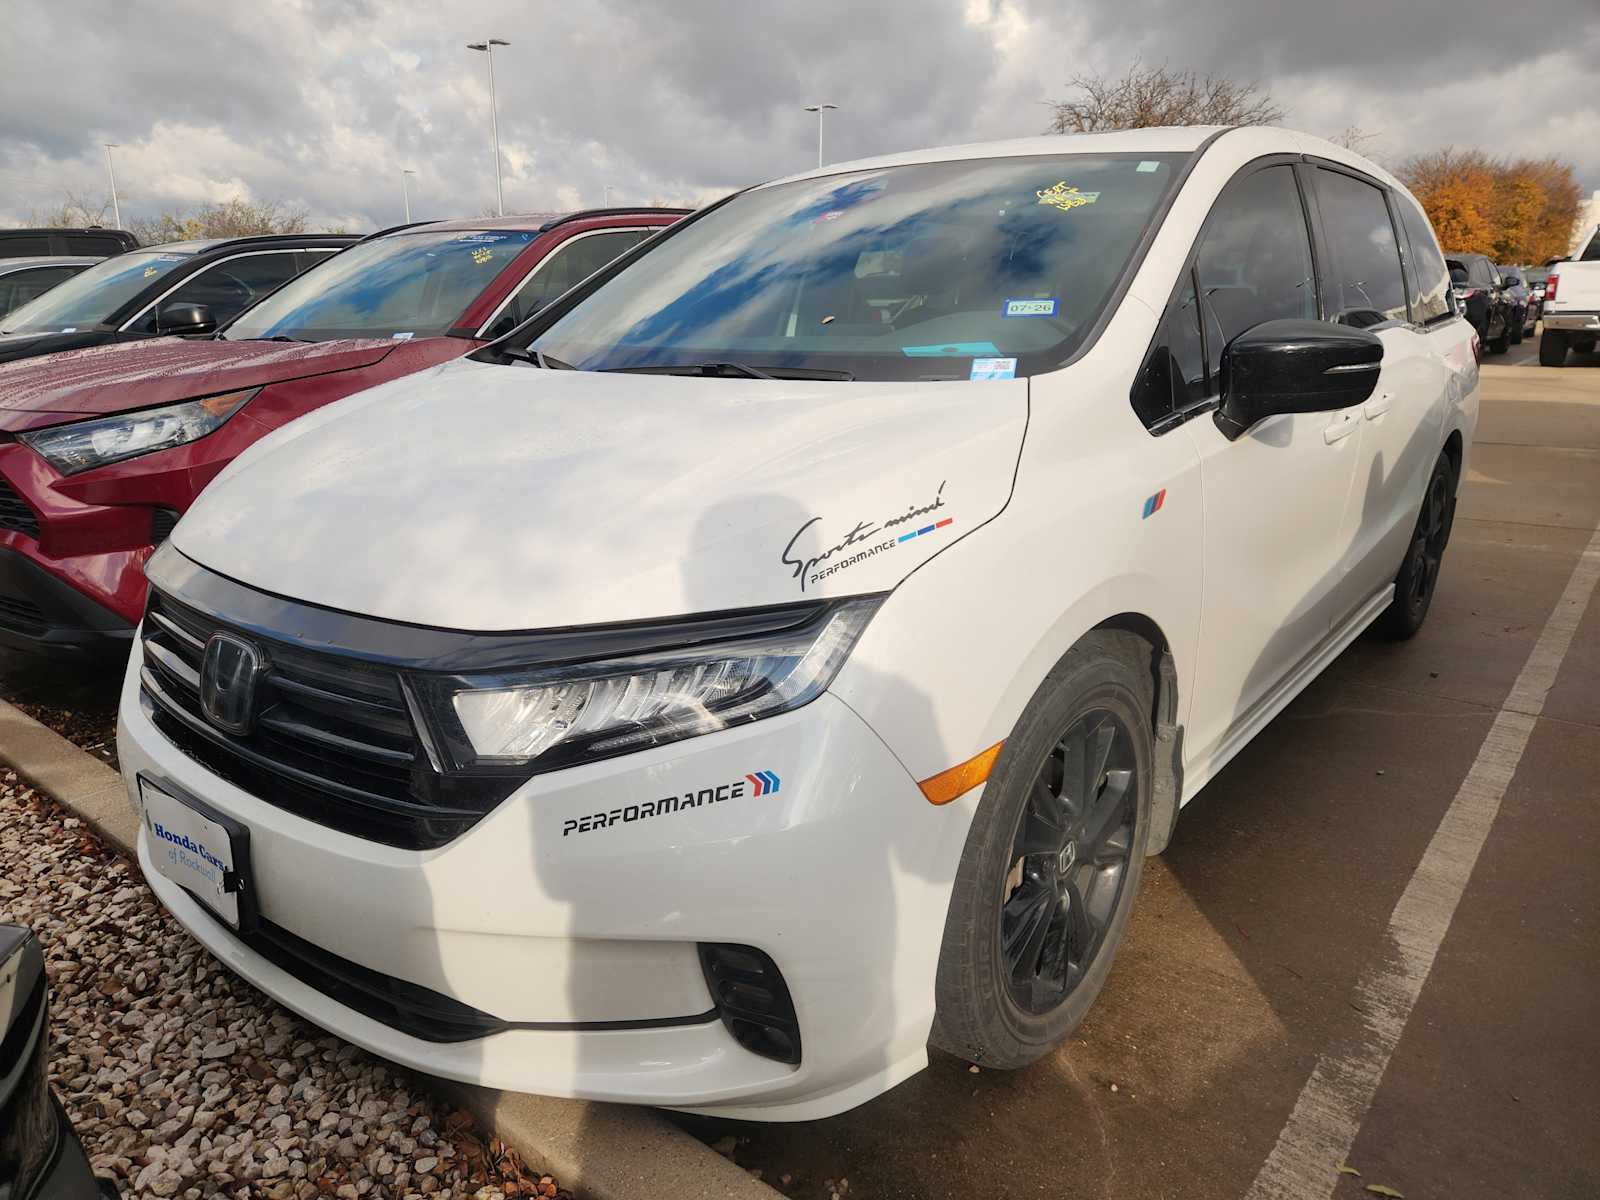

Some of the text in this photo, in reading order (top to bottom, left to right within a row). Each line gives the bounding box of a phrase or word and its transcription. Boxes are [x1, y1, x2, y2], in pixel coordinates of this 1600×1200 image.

[811, 539, 896, 584] PERFORMANCE
[563, 781, 745, 836] PERFORMANCE
[154, 823, 225, 871] Honda Cars
